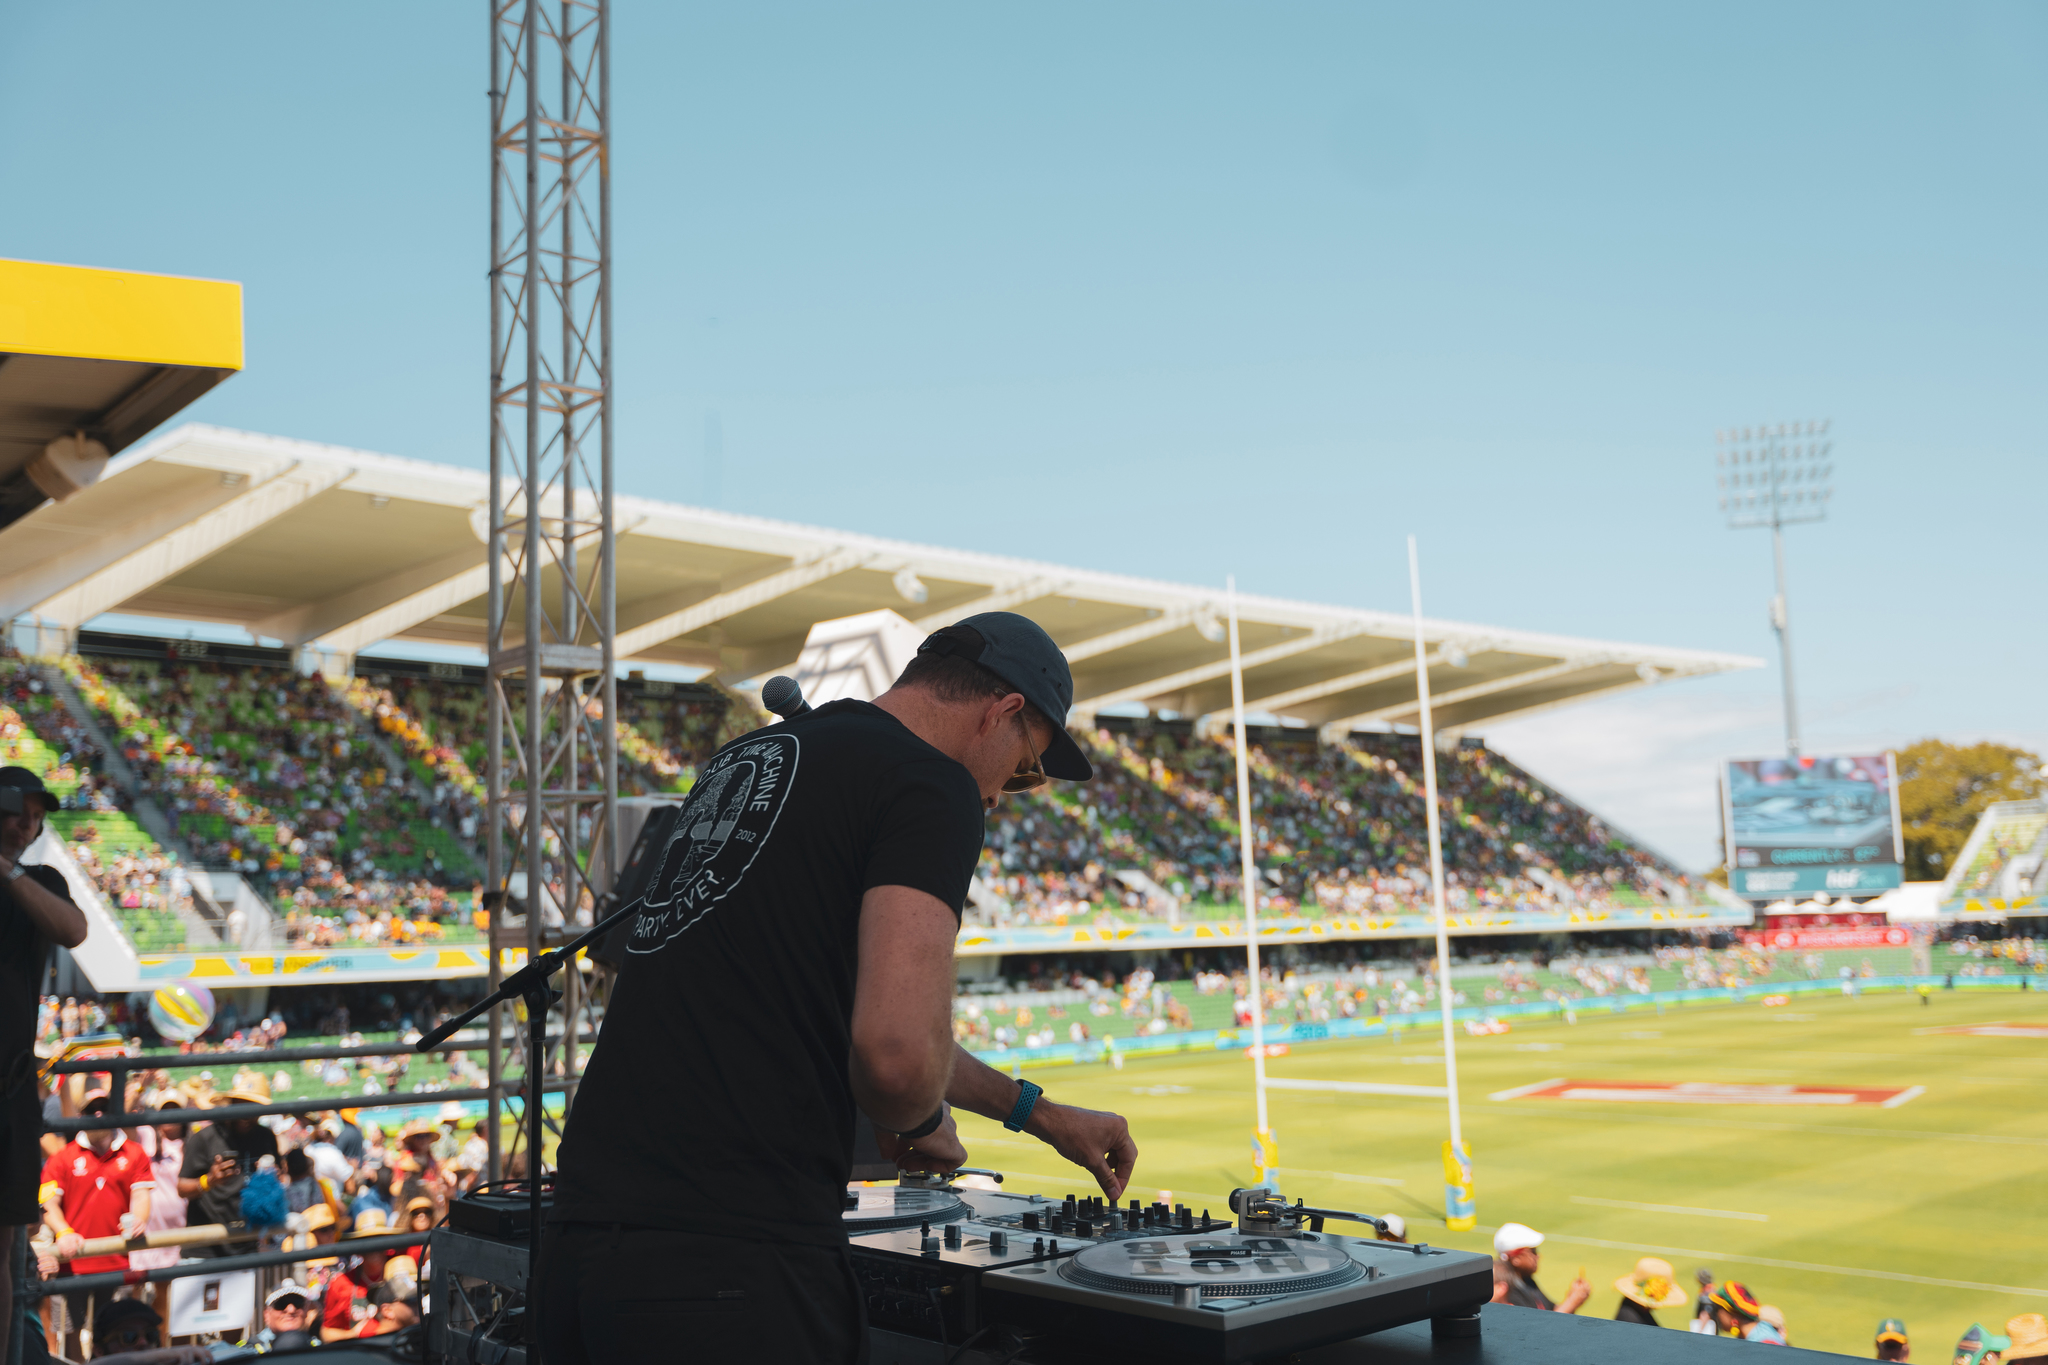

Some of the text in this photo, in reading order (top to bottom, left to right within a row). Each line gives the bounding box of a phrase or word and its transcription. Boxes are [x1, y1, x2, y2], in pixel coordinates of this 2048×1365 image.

[737, 742, 773, 759] TIME
[749, 743, 783, 811] MACHINE
[735, 829, 757, 843] 2012
[1130, 1258, 1310, 1276] HOT
